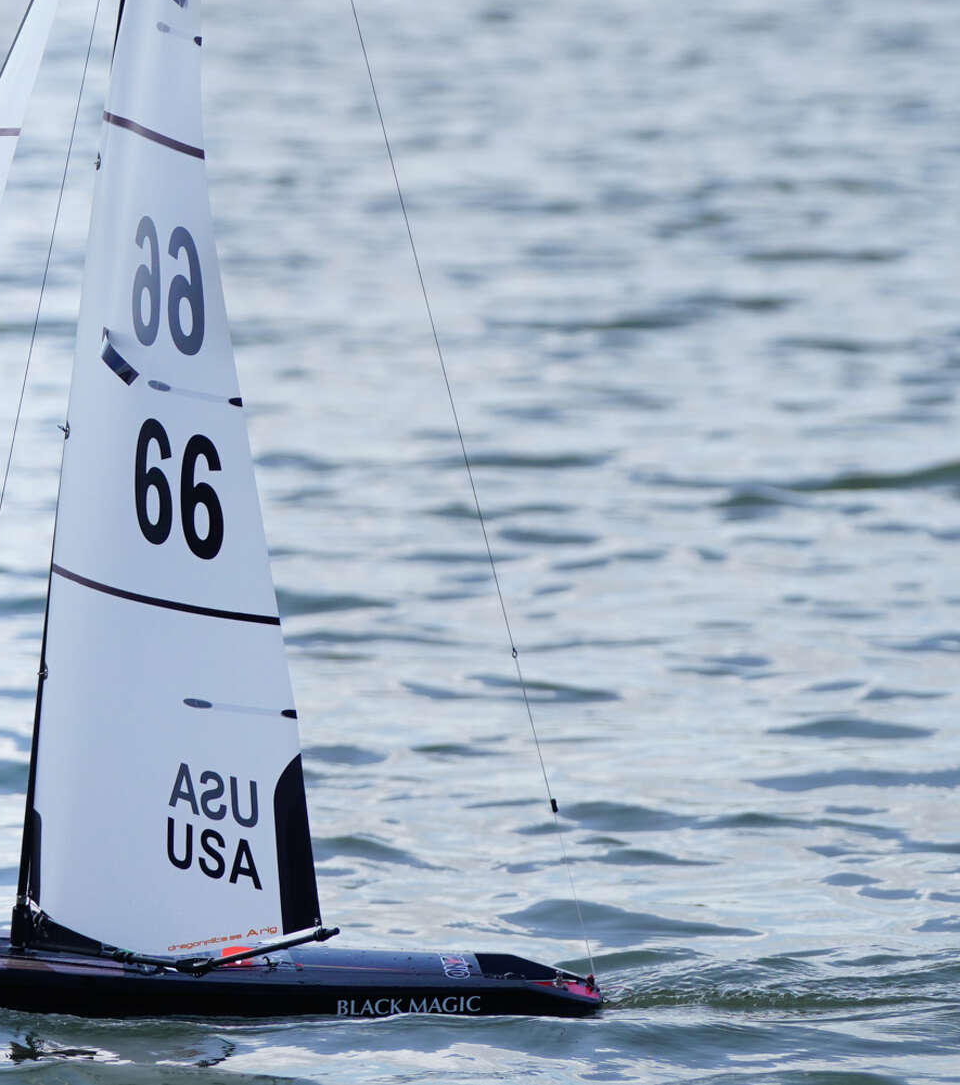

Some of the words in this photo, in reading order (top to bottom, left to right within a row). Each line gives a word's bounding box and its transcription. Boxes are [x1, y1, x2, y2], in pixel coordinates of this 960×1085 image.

[134, 418, 224, 560] 66
[167, 816, 263, 891] USA
[336, 998, 402, 1016] BLACK
[408, 995, 481, 1013] MAGIC
